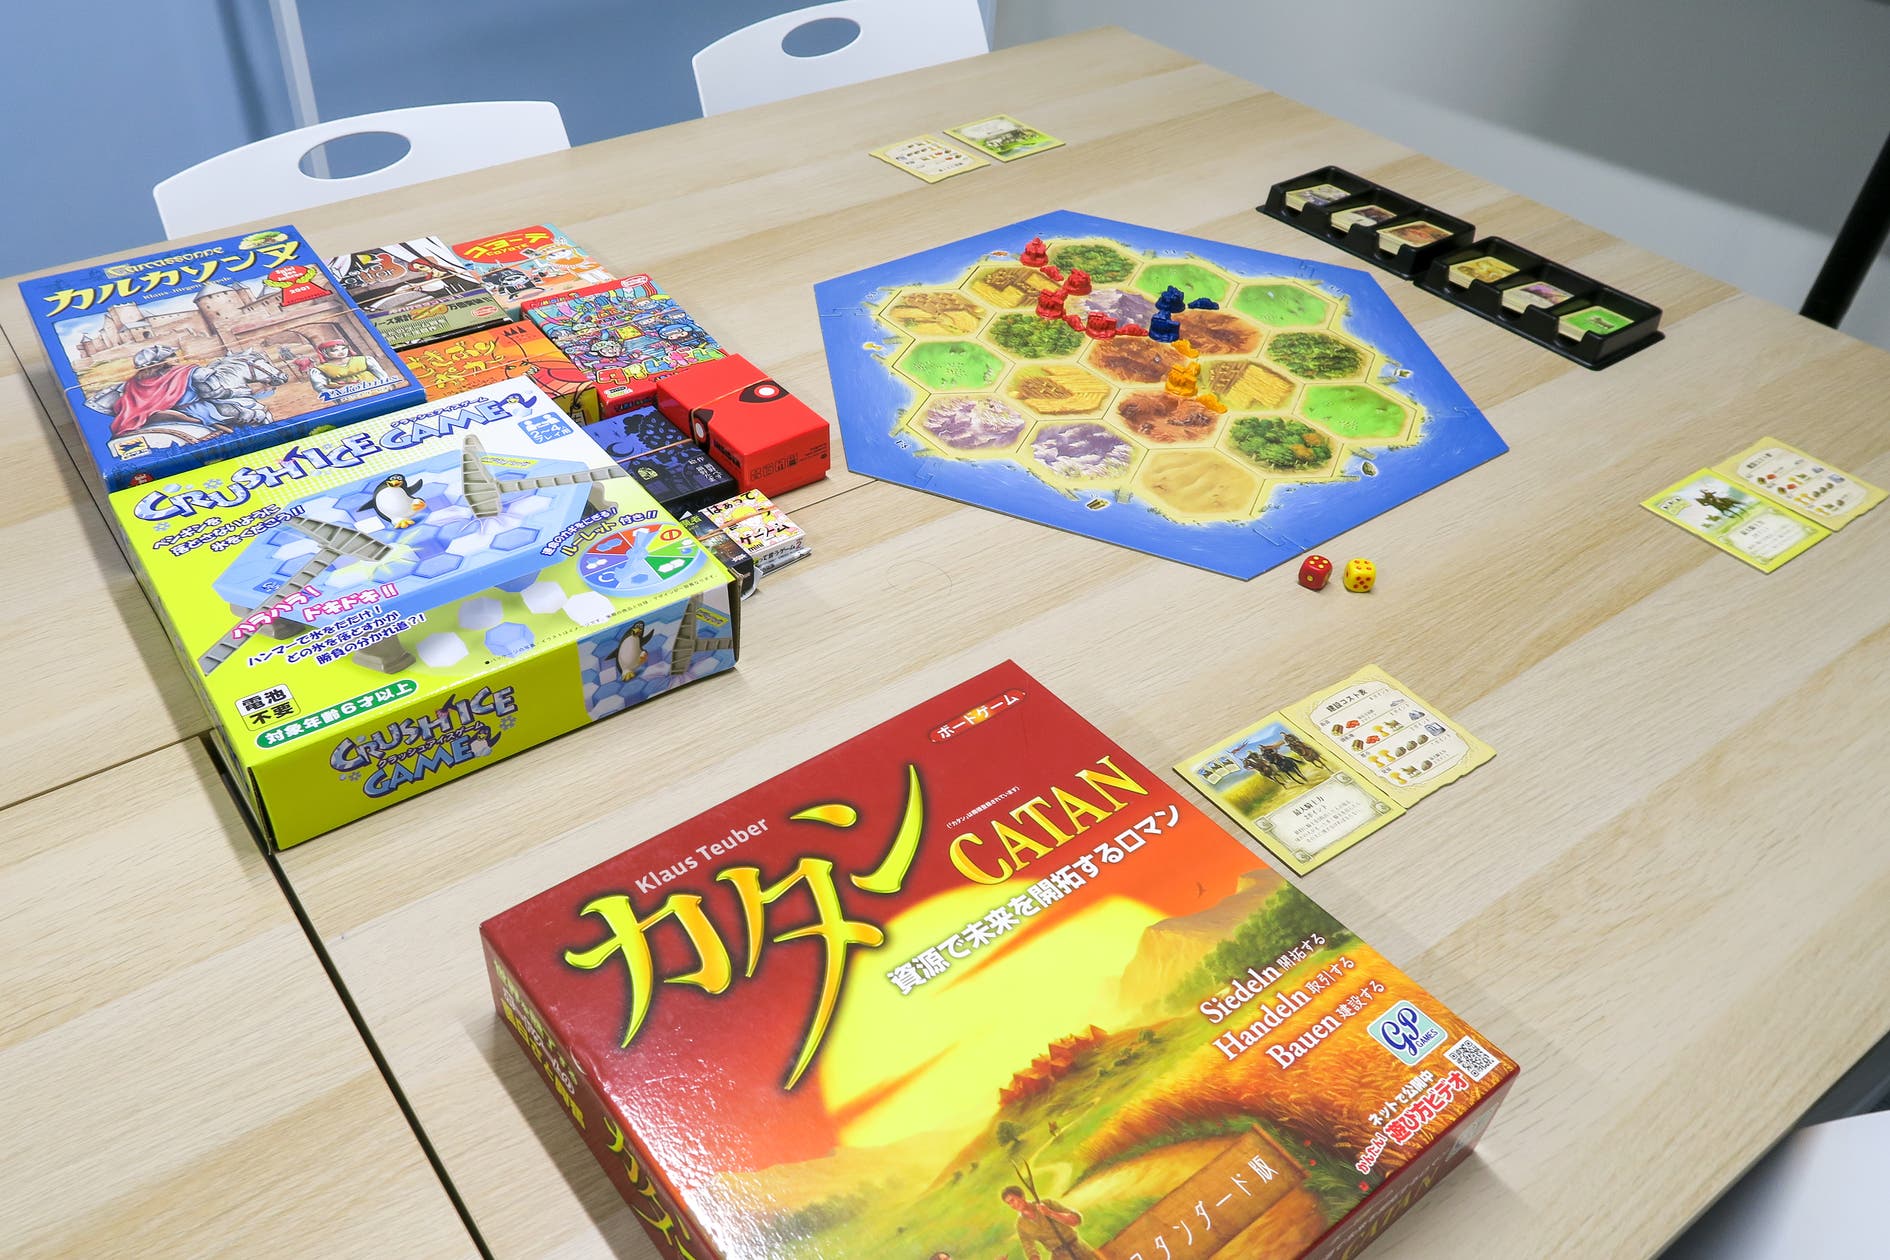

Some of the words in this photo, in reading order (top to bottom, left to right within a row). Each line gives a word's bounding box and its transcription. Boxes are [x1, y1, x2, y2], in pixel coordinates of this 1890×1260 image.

[104, 245, 225, 279] Carcassonne
[463, 232, 550, 259] コヨーテ
[45, 240, 302, 319] カルカソンヌ
[289, 285, 311, 294] 2001
[134, 452, 307, 521] CRUSH
[299, 432, 381, 473] ICE
[379, 399, 512, 452] GAME
[153, 516, 222, 550] ペンギンを
[169, 503, 281, 557] 落とさないように
[560, 521, 616, 557] ルーレット
[748, 543, 764, 553] mini
[232, 585, 322, 639] ハラハラ!
[242, 689, 287, 712] 電池
[249, 702, 294, 726] 不要
[264, 682, 413, 746] 対象年齢6才以上
[937, 693, 1021, 740] ボードゲーム
[330, 709, 454, 773] CRUSH
[454, 685, 518, 726] ICE
[377, 720, 485, 769] クラッシュアイスゲーム
[362, 735, 476, 799] GAME
[949, 755, 1150, 886] CATAN
[635, 860, 698, 896] Klaus
[694, 817, 770, 863] Teuber
[564, 763, 924, 1092] カタン
[886, 804, 1180, 997] 資源で未来を開拓するロマン
[1200, 964, 1283, 1024] Siedeln
[1276, 932, 1327, 972] 開拓する
[1213, 988, 1312, 1061] Handeln
[1304, 955, 1356, 997] 取引する
[1265, 1013, 1342, 1071] Bauen
[1335, 979, 1386, 1021] 建設する
[1380, 1007, 1421, 1057] GP
[1415, 1029, 1440, 1049] GAMES
[1368, 1070, 1435, 1126] ネットで公開中
[1383, 1071, 1469, 1146] 遊び方ビデオ
[1355, 1132, 1388, 1175] かんたん!
